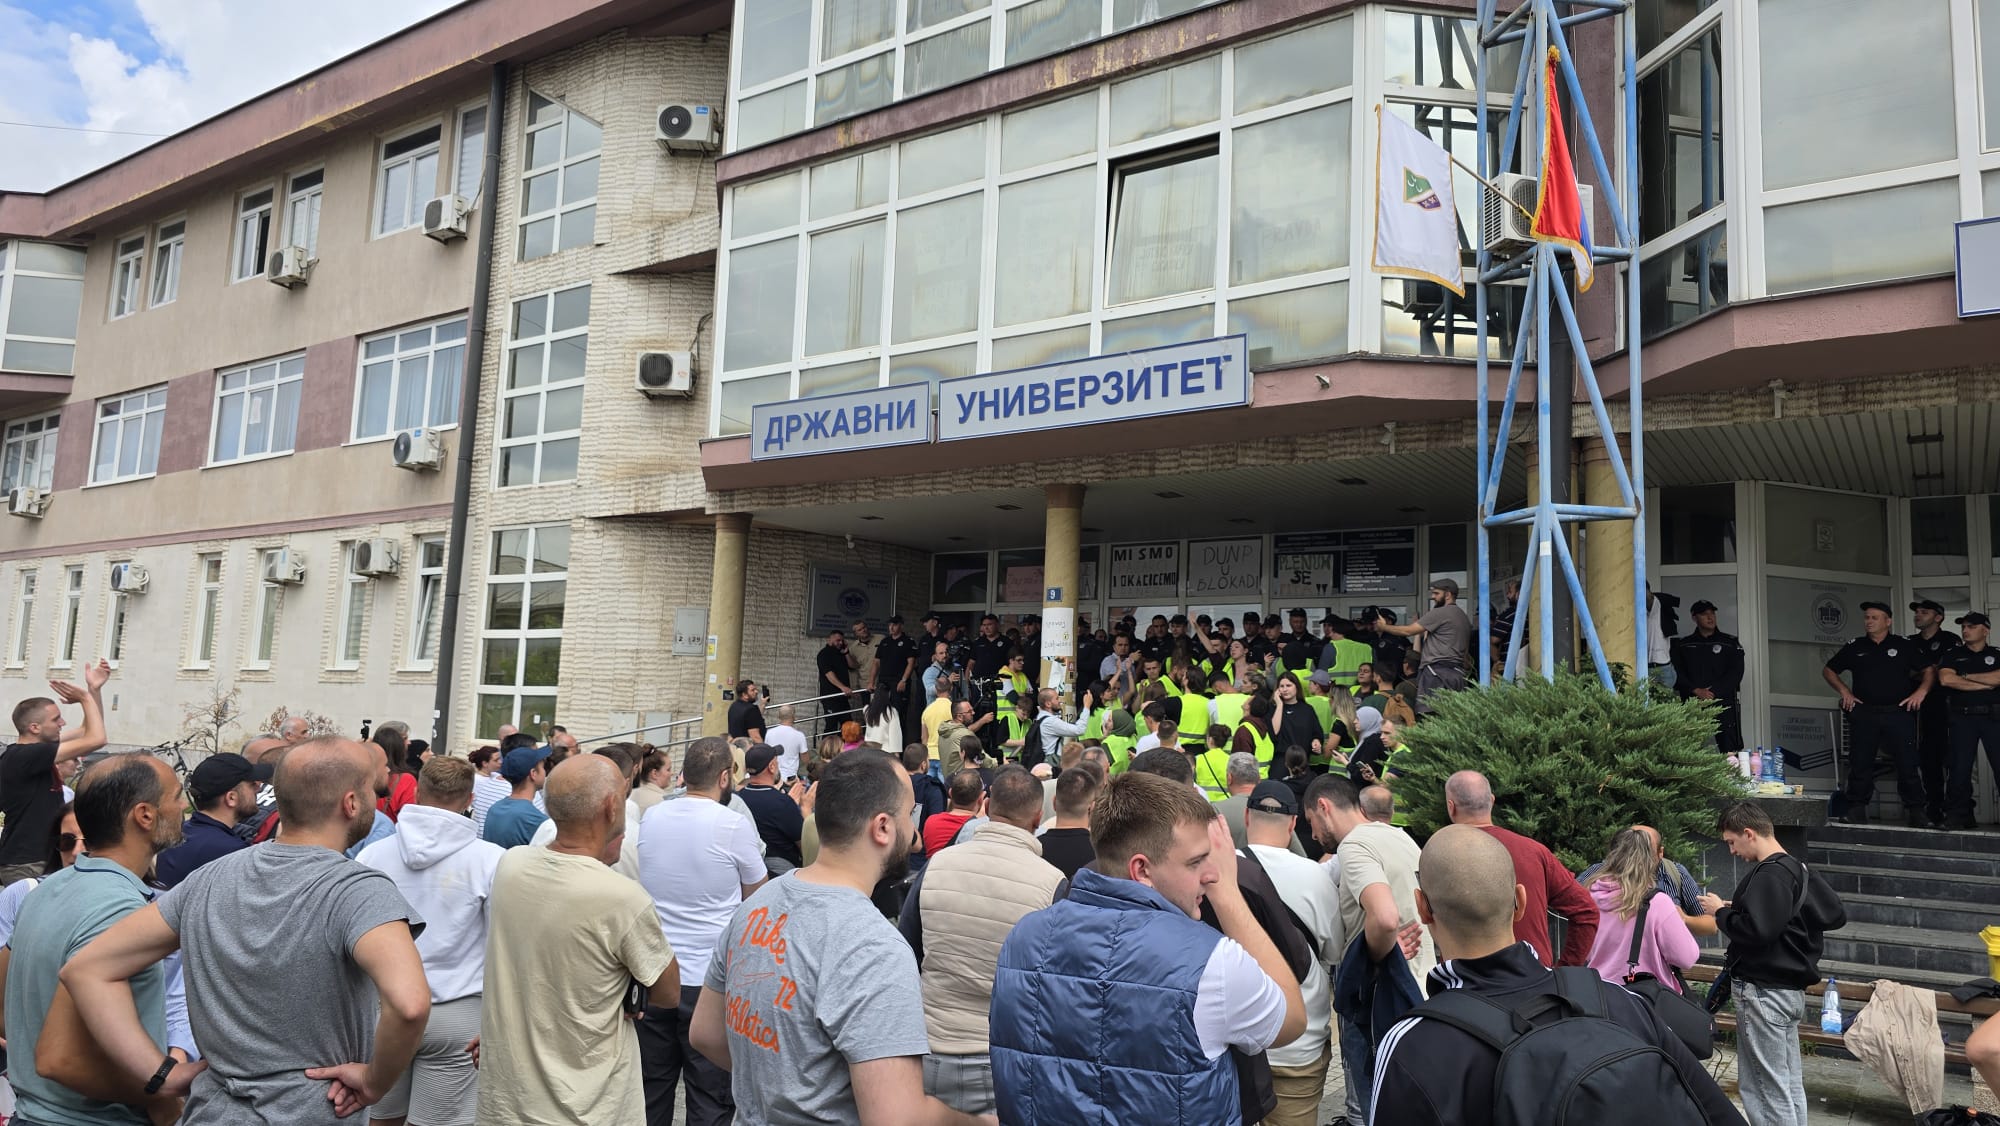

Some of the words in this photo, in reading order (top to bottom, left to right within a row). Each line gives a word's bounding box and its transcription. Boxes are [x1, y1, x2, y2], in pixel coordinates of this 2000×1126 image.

[764, 399, 916, 452] ДРЖАВНИ
[956, 355, 1232, 424] УНИВЕРЗИТЕТ
[1114, 549, 1132, 562] MI
[1138, 547, 1173, 561] SMO
[1202, 545, 1253, 565] DUNP
[1220, 564, 1230, 576] U
[1280, 555, 1331, 570] PLENUM
[1290, 570, 1312, 585] SE
[1049, 589, 1056, 600] 9
[739, 906, 788, 965] Nike
[774, 975, 798, 1012] 72
